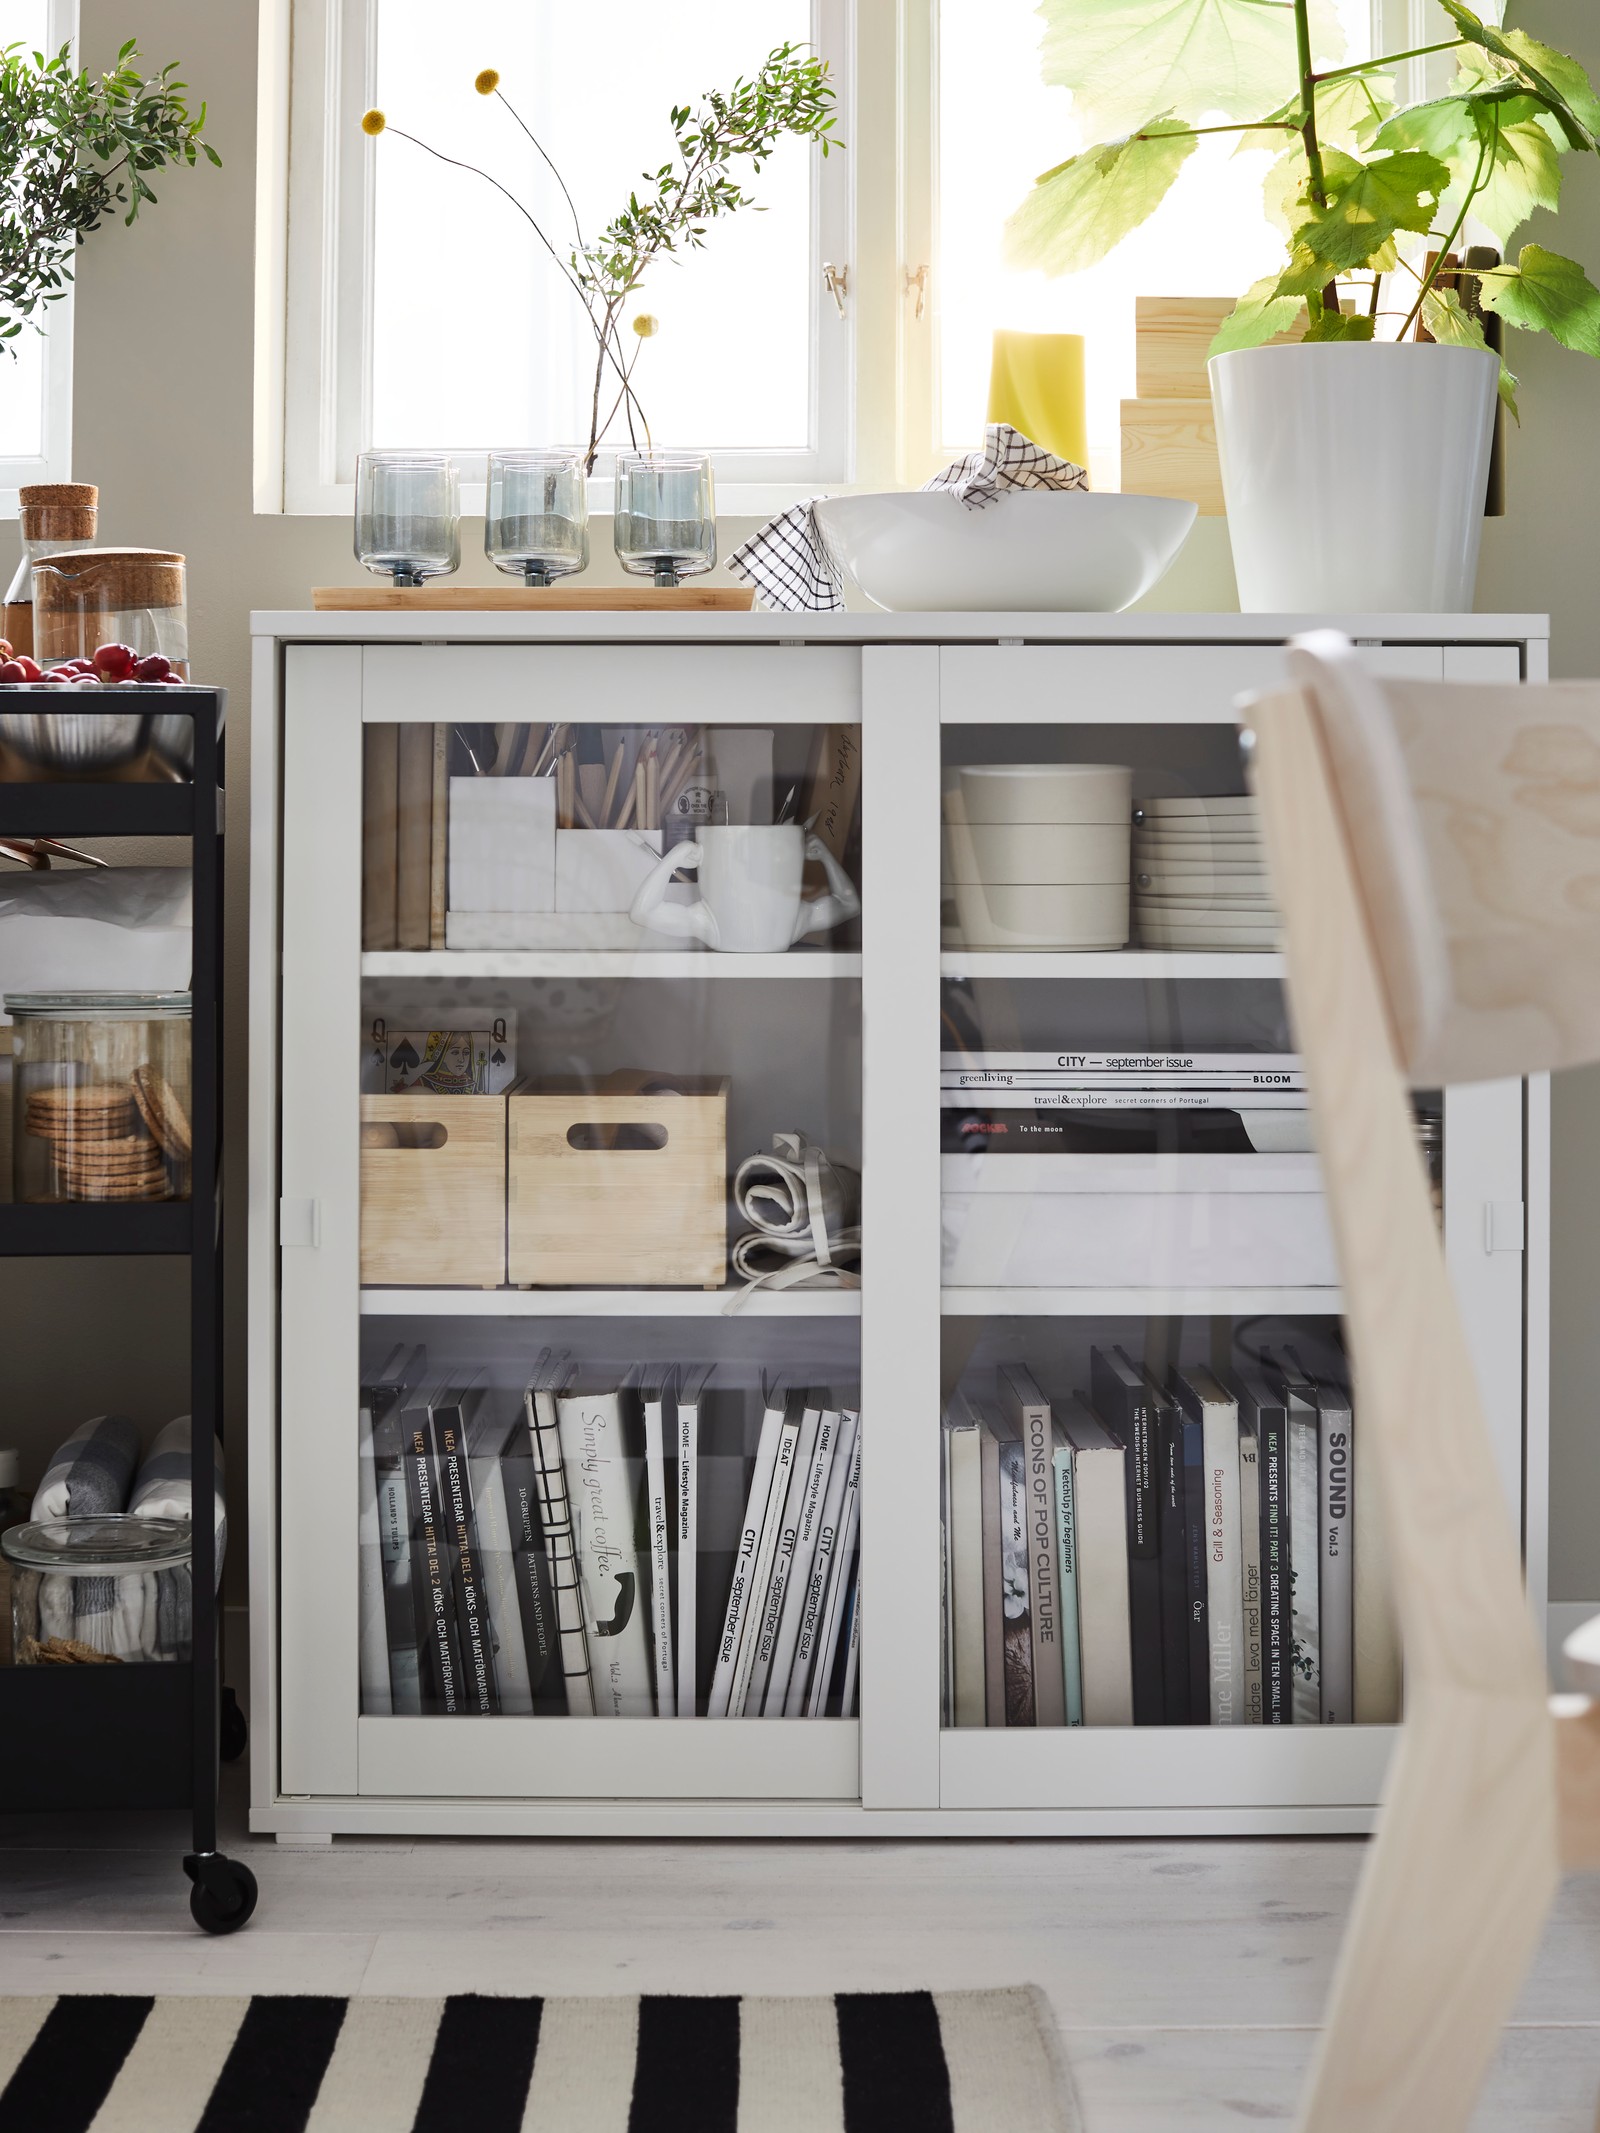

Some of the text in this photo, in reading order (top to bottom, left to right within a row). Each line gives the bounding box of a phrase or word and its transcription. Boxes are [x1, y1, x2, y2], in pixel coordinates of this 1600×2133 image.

[371, 1018, 386, 1043] Q
[492, 1018, 507, 1043] Q
[1057, 1056, 1193, 1069] CITY september issue
[959, 1073, 1013, 1084] greenliving
[1253, 1075, 1291, 1083] BLOOM
[1034, 1095, 1107, 1107] travel&explore
[1179, 1097, 1209, 1105] Portugal
[580, 1411, 612, 1474] Simply
[1141, 1407, 1149, 1462] INTERNETBOKEN
[780, 1438, 793, 1466] IDEAT
[416, 1456, 433, 1524] PRESENTERAR
[447, 1456, 465, 1523] PRESENTERAR
[680, 1421, 690, 1539] HOME Lifestyle Magazine
[803, 1425, 831, 1541] HOME Lifestyle Magazine
[1269, 1456, 1279, 1501] PRESENTS
[582, 1478, 609, 1521] great
[1009, 1461, 1022, 1541] Mindfulness and Me
[1328, 1432, 1347, 1557] SOUND Vol.3
[389, 1487, 400, 1551] HOLLAND'S TULIPS
[1030, 1414, 1054, 1643] ICONS OF POP CULTURE
[1061, 1468, 1074, 1574] KetchUp for beginners
[1212, 1469, 1224, 1562] Grill & Seasoning
[1270, 1504, 1279, 1524] FIND
[425, 1526, 437, 1557] HITTA!
[456, 1525, 468, 1555] HITTA!
[653, 1497, 665, 1570] travel&explore
[781, 1529, 796, 1557] CITY
[1270, 1527, 1279, 1538] IT!
[1270, 1540, 1279, 1562] PART
[429, 1559, 439, 1576] DEL
[461, 1557, 471, 1575] DEL
[463, 1576, 472, 1584] 2
[519, 1487, 548, 1656] 10-GRUPPEN PATTERNS AND PEOPLE
[431, 1577, 440, 1585] 2
[658, 1577, 666, 1599] secret
[721, 1529, 756, 1662] CITY september issue
[799, 1526, 834, 1660] CITY september issue
[1271, 1574, 1280, 1616] CREATING
[432, 1587, 446, 1616] KÖKS-
[465, 1586, 478, 1615] KÖKS-
[766, 1576, 786, 1632] september
[1192, 1600, 1205, 1623] Öar
[436, 1619, 448, 1638] OCH
[468, 1618, 479, 1638] OCH
[659, 1601, 667, 1630] corners
[1244, 1608, 1260, 1637] med
[1271, 1618, 1280, 1646] SPACE
[660, 1641, 668, 1672] Portugal
[760, 1633, 775, 1662] issue
[1212, 1620, 1232, 1684] Miller
[1245, 1643, 1260, 1672] Leva
[1272, 1649, 1281, 1658] IN
[438, 1641, 458, 1712] MATFÖRVARING
[472, 1640, 489, 1709] MATFÖRVARING
[1272, 1661, 1281, 1677] TEN
[1272, 1680, 1281, 1709] SMALL
